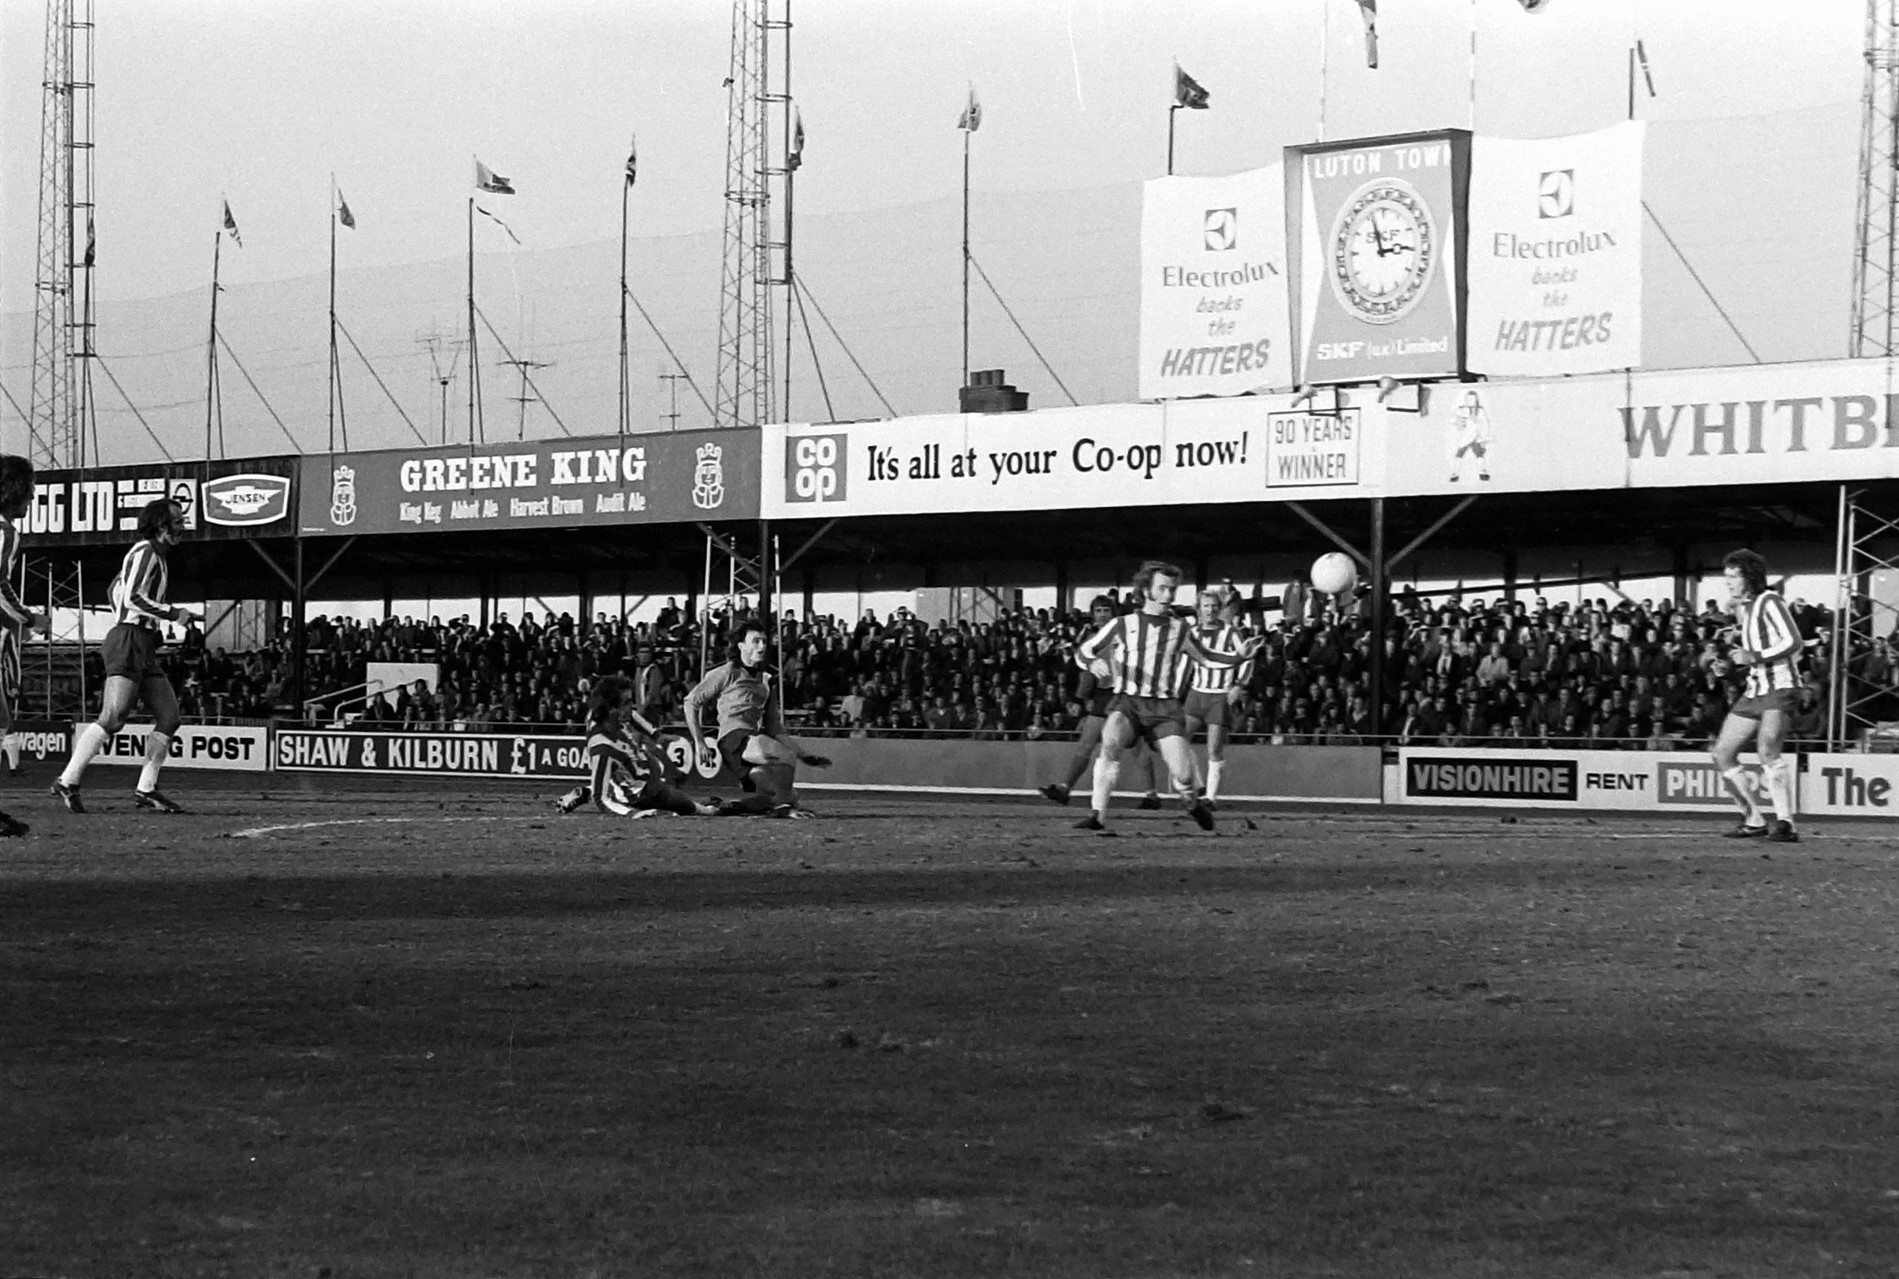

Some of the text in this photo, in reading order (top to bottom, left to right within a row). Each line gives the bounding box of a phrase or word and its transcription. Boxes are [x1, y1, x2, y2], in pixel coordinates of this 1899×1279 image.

[1313, 151, 1382, 179] LUTON
[1492, 230, 1617, 260] Electrolux
[1162, 261, 1279, 288] Electrolux
[1531, 265, 1579, 285] backs
[1196, 295, 1244, 314] backs
[1208, 317, 1237, 337] the
[1494, 310, 1614, 351] HATTERS
[1160, 337, 1271, 378] HATTERS
[1316, 341, 1365, 360] SKF
[1397, 335, 1449, 355] Limited
[1275, 415, 1353, 444] 90 YEARS
[400, 447, 648, 493] GREENE KING
[867, 430, 1250, 485] It's all at your Co-op now!
[1277, 452, 1347, 480] WINNER
[71, 481, 114, 532] LTD
[224, 493, 267, 504] JENSEN
[399, 502, 423, 525] King
[450, 499, 480, 519] Abbot
[482, 498, 499, 519] Ale
[510, 497, 550, 518] Harvest
[551, 495, 584, 516] Brown
[627, 491, 647, 512] Ale
[97, 733, 256, 761] VENG POST
[280, 735, 592, 775] SHAW & KILBURN £1 A GOA
[1413, 763, 1570, 795] VISIONHIRE
[1587, 772, 1650, 792] RENT
[1666, 768, 1771, 799] PHILPS
[1820, 766, 1892, 807] The
